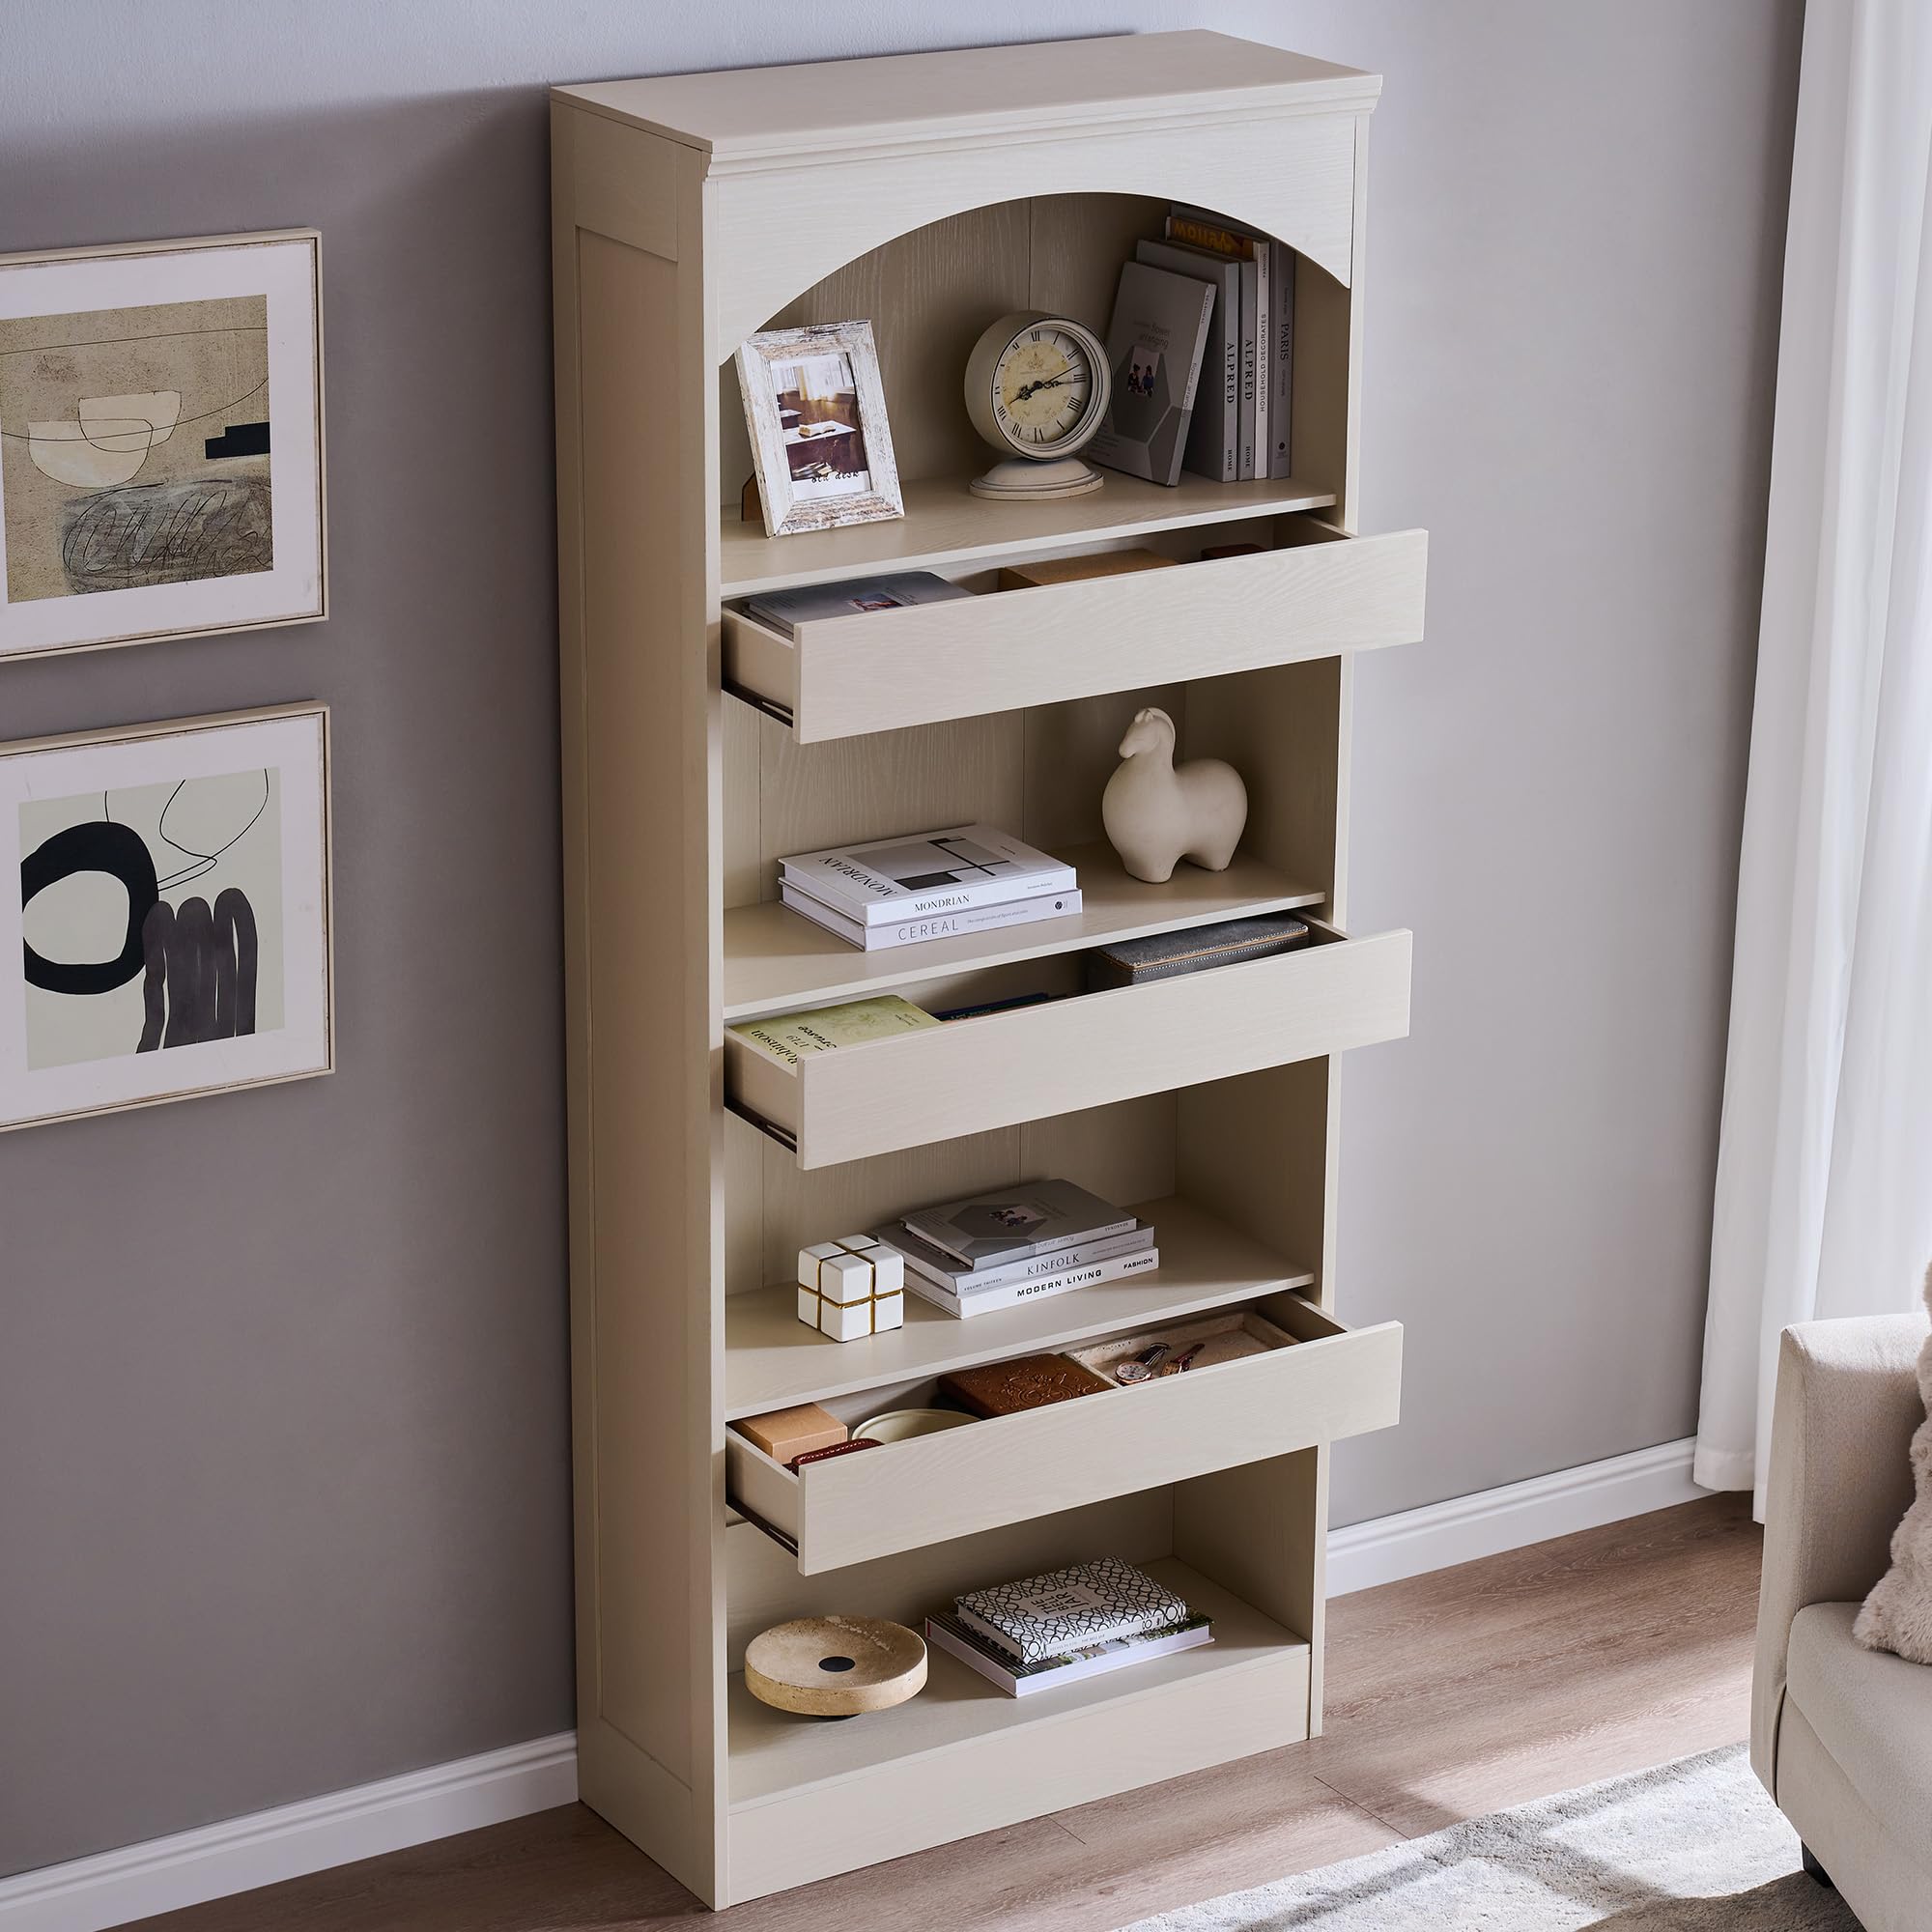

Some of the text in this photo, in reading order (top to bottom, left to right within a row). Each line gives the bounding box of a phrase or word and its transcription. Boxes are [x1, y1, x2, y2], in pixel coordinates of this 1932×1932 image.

[1280, 324, 1290, 361] PARIS
[819, 857, 897, 896] MONDRIAN
[915, 895, 970, 912] MONDRIAN
[898, 919, 959, 941] CEREAL
[1027, 1253, 1080, 1275] KINFOLK
[1123, 1257, 1153, 1269] FASHION
[1017, 1269, 1102, 1297] MODERN LIVING
[1031, 1599, 1057, 1614] THE
[1045, 1596, 1069, 1611] BELL
[1056, 1592, 1090, 1607] JAR
